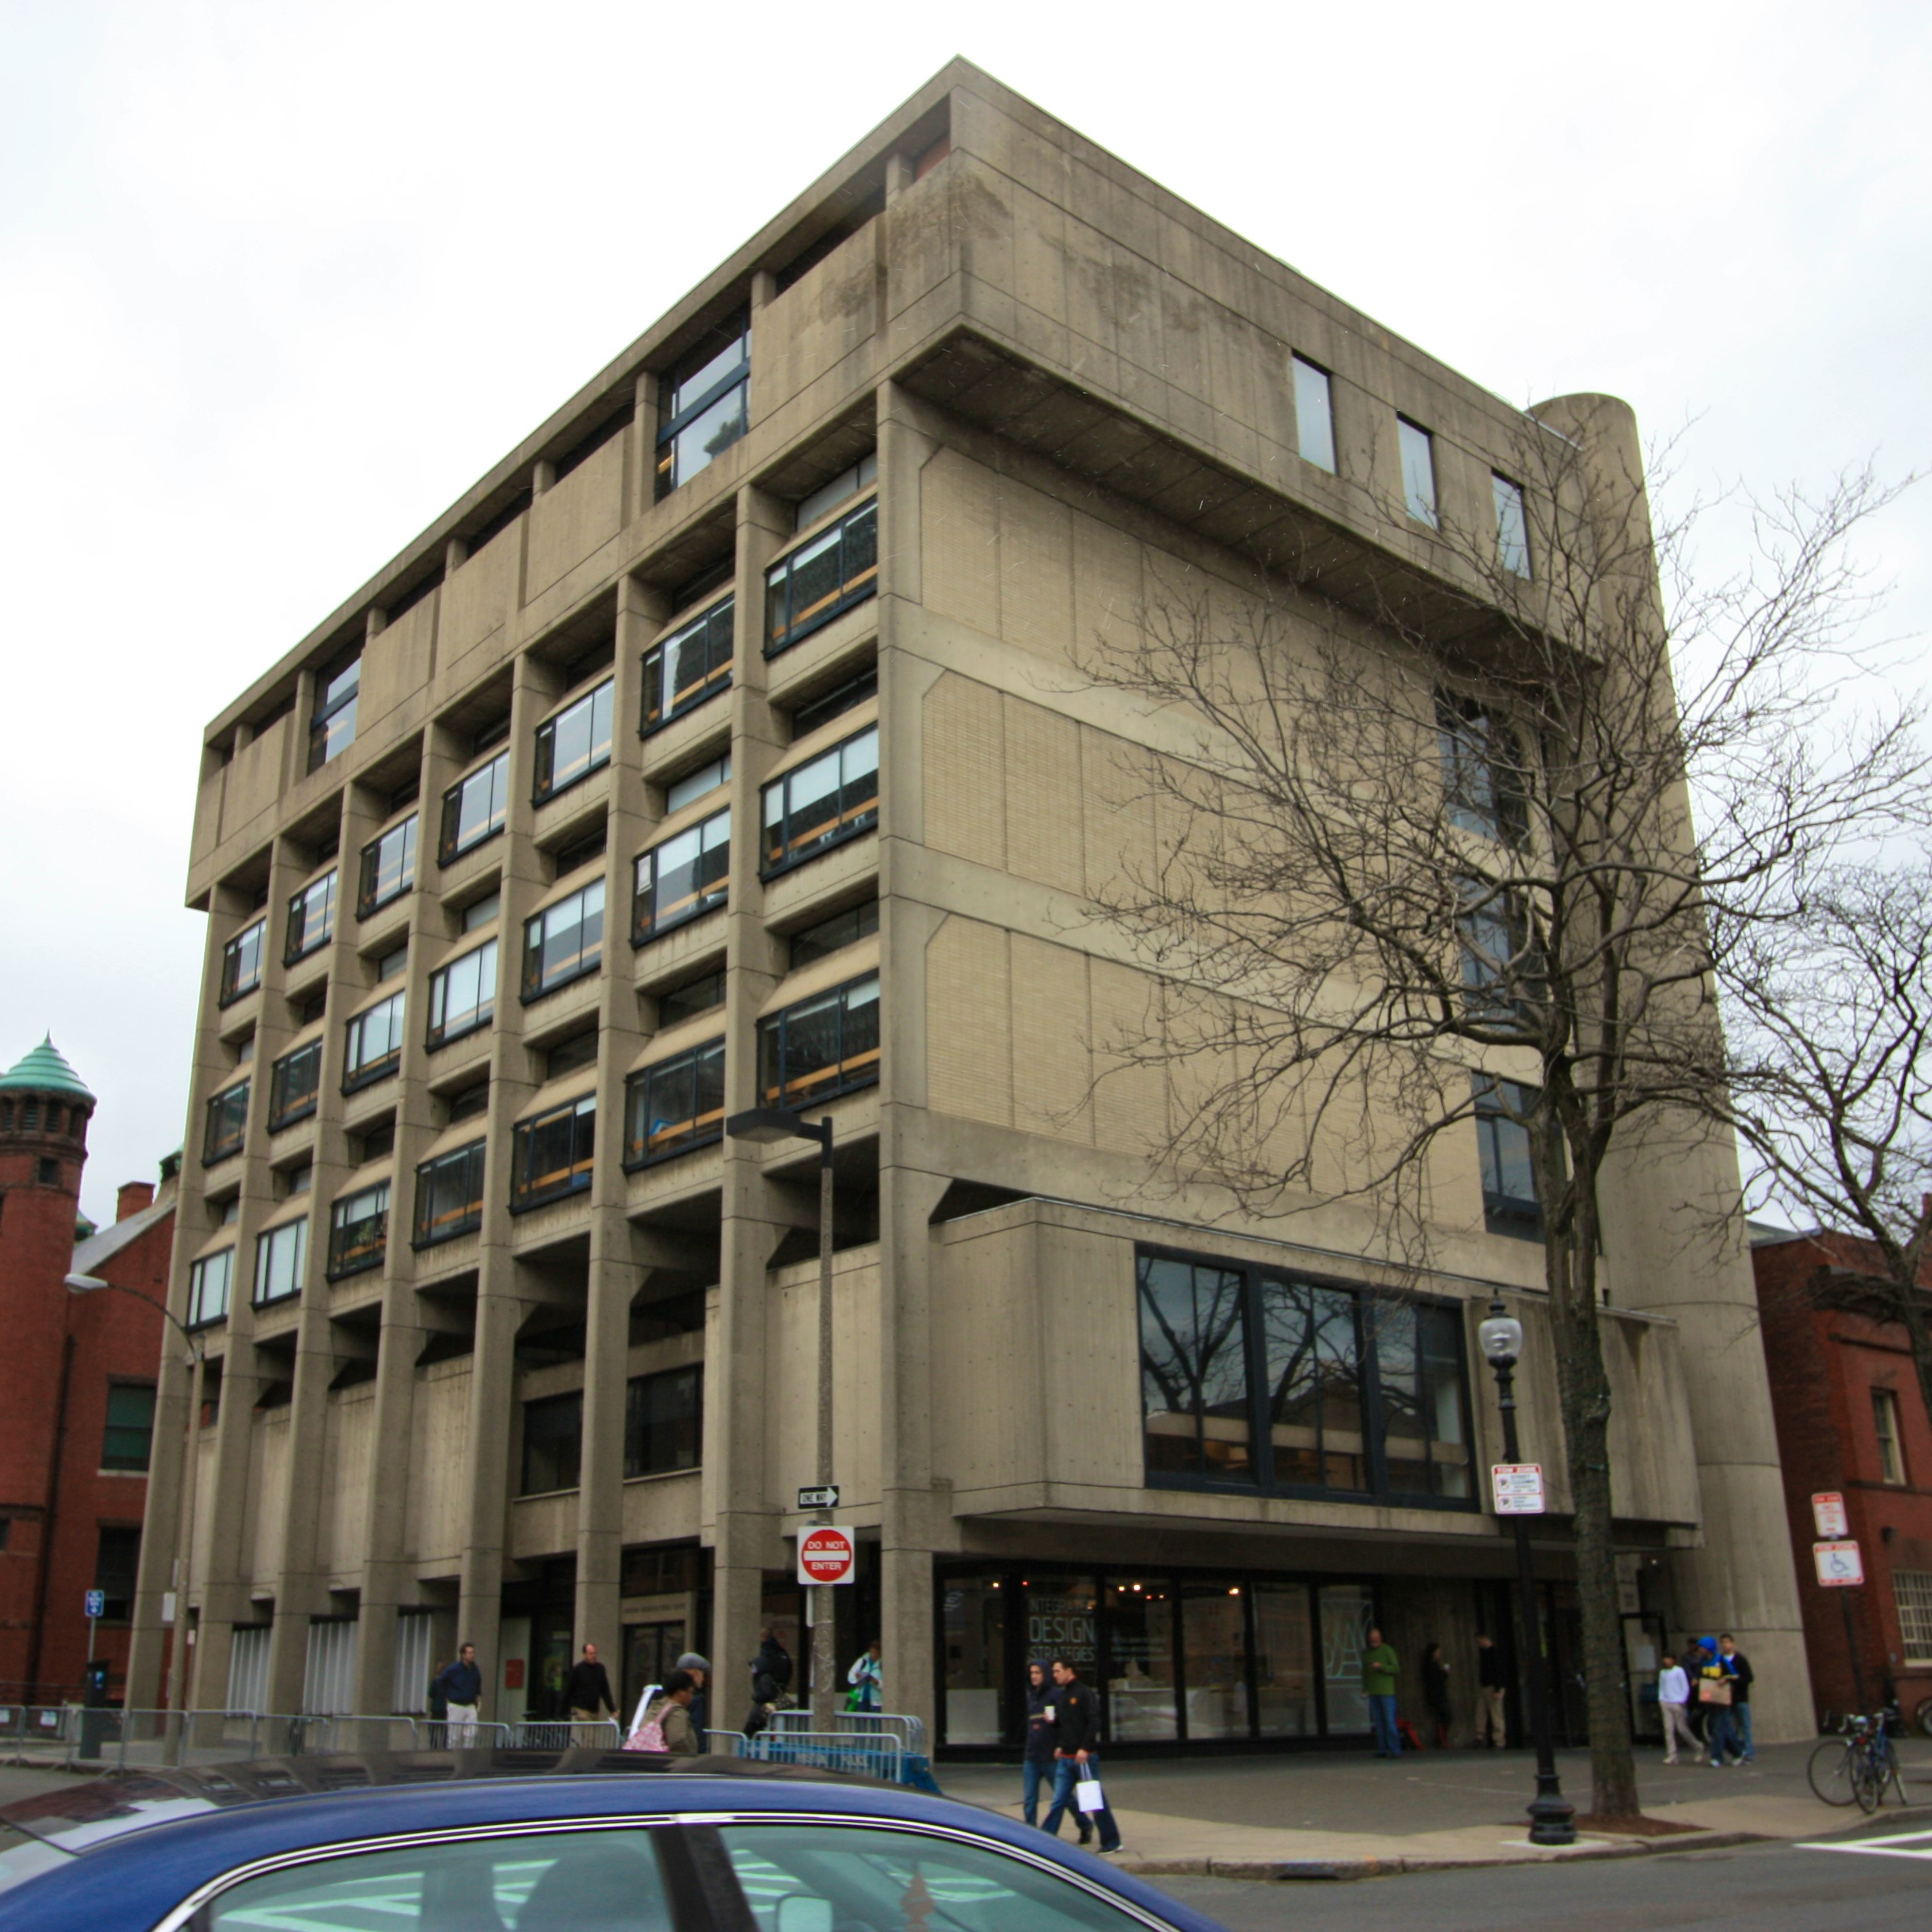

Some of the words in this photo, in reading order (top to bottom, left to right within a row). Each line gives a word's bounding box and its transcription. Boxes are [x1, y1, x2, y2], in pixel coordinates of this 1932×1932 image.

[803, 1494, 813, 1503] ONE
[816, 1493, 826, 1501] WAY
[807, 1541, 822, 1549] DO
[826, 1541, 845, 1549] NOT
[811, 1562, 842, 1570] ENTER
[1029, 1617, 1095, 1642] DESIGN
[1029, 1646, 1095, 1661] STRATEGIES
